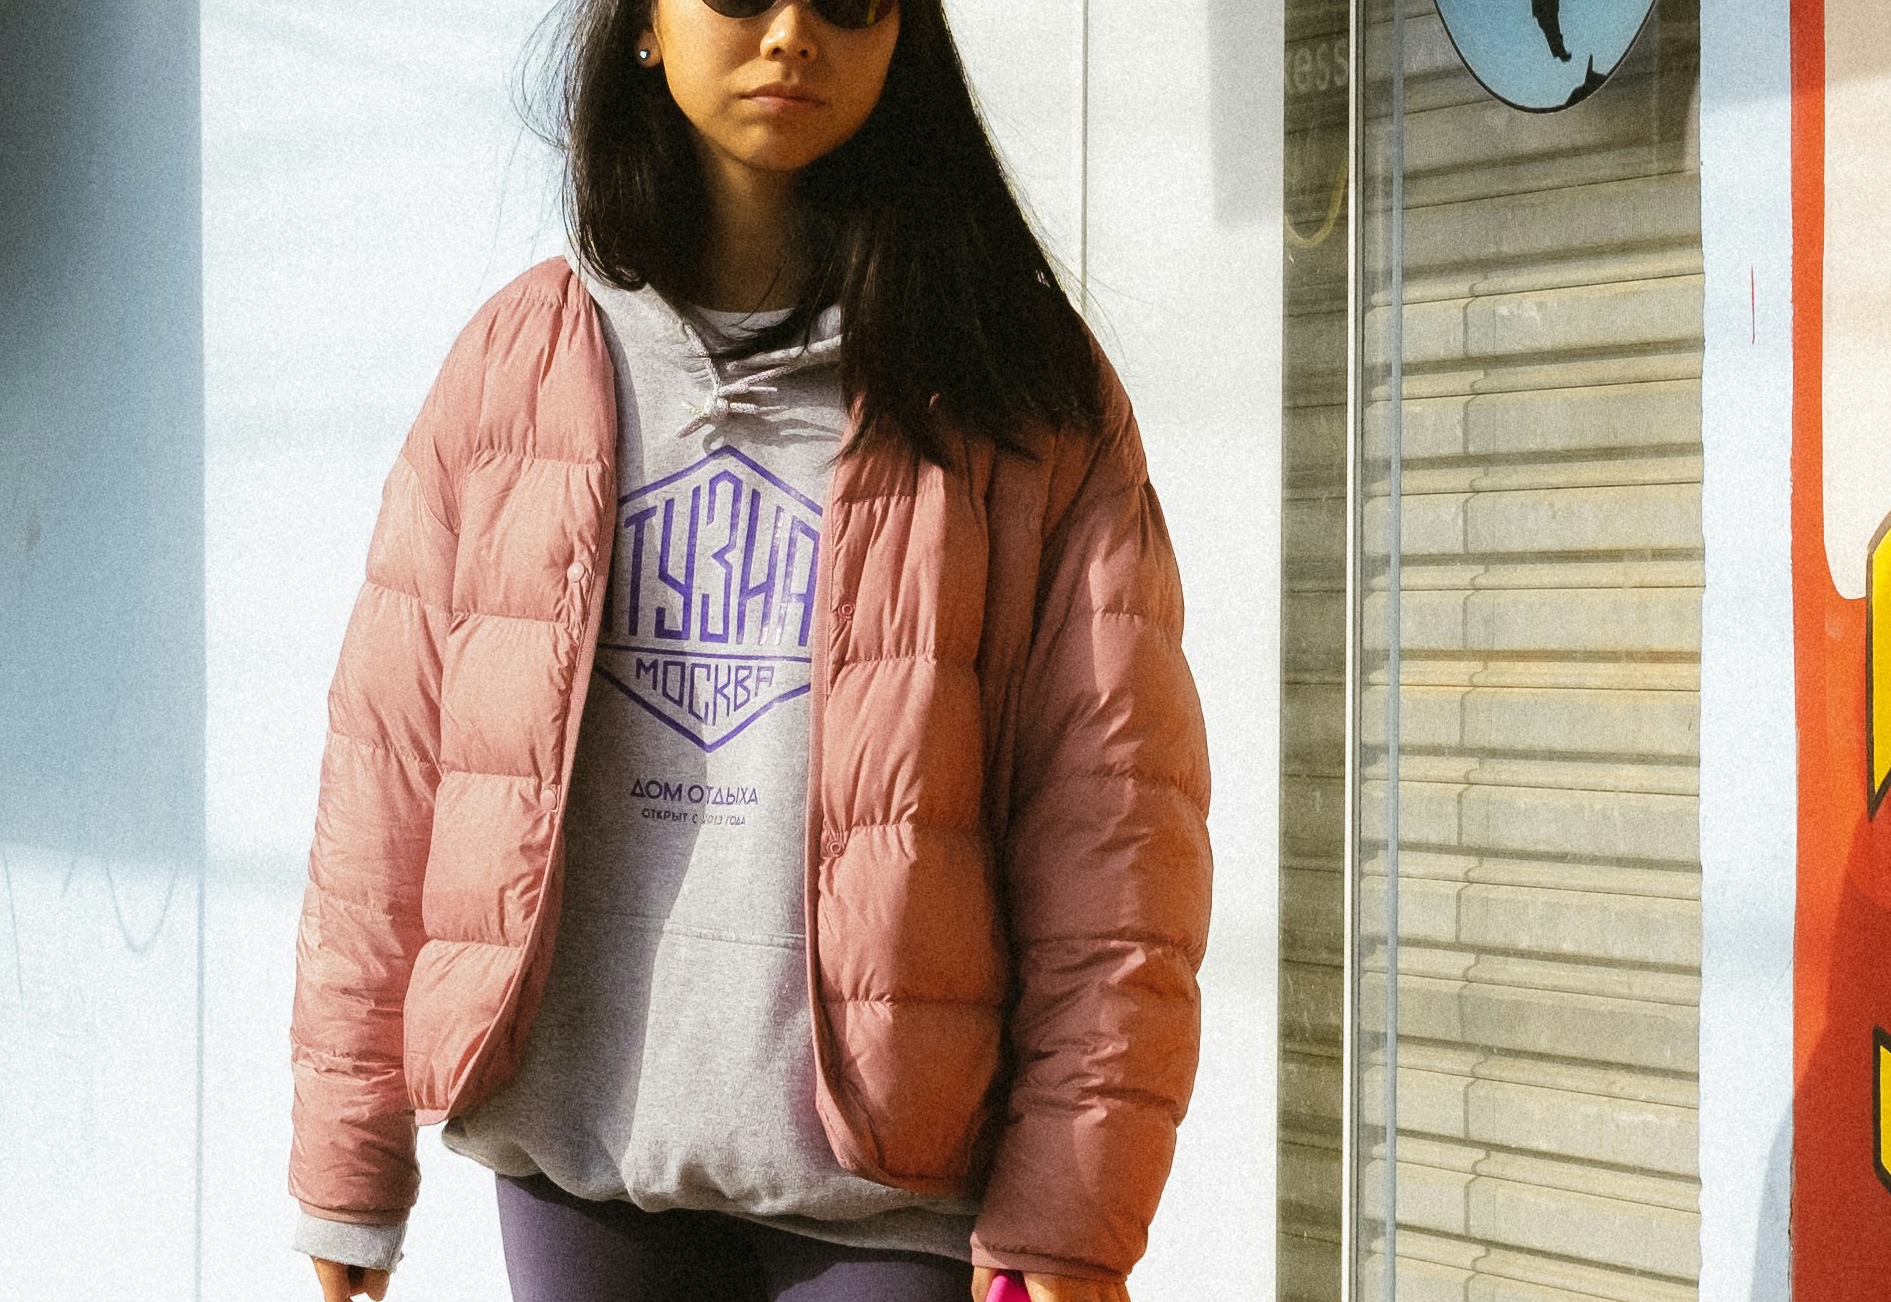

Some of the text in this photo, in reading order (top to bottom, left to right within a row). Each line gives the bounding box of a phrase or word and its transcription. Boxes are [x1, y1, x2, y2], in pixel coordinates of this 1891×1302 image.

[635, 657, 776, 726] МОСКВА
[630, 778, 759, 806] ДОМ ОТДЫХА
[641, 807, 688, 823] ОТКРЫТ
